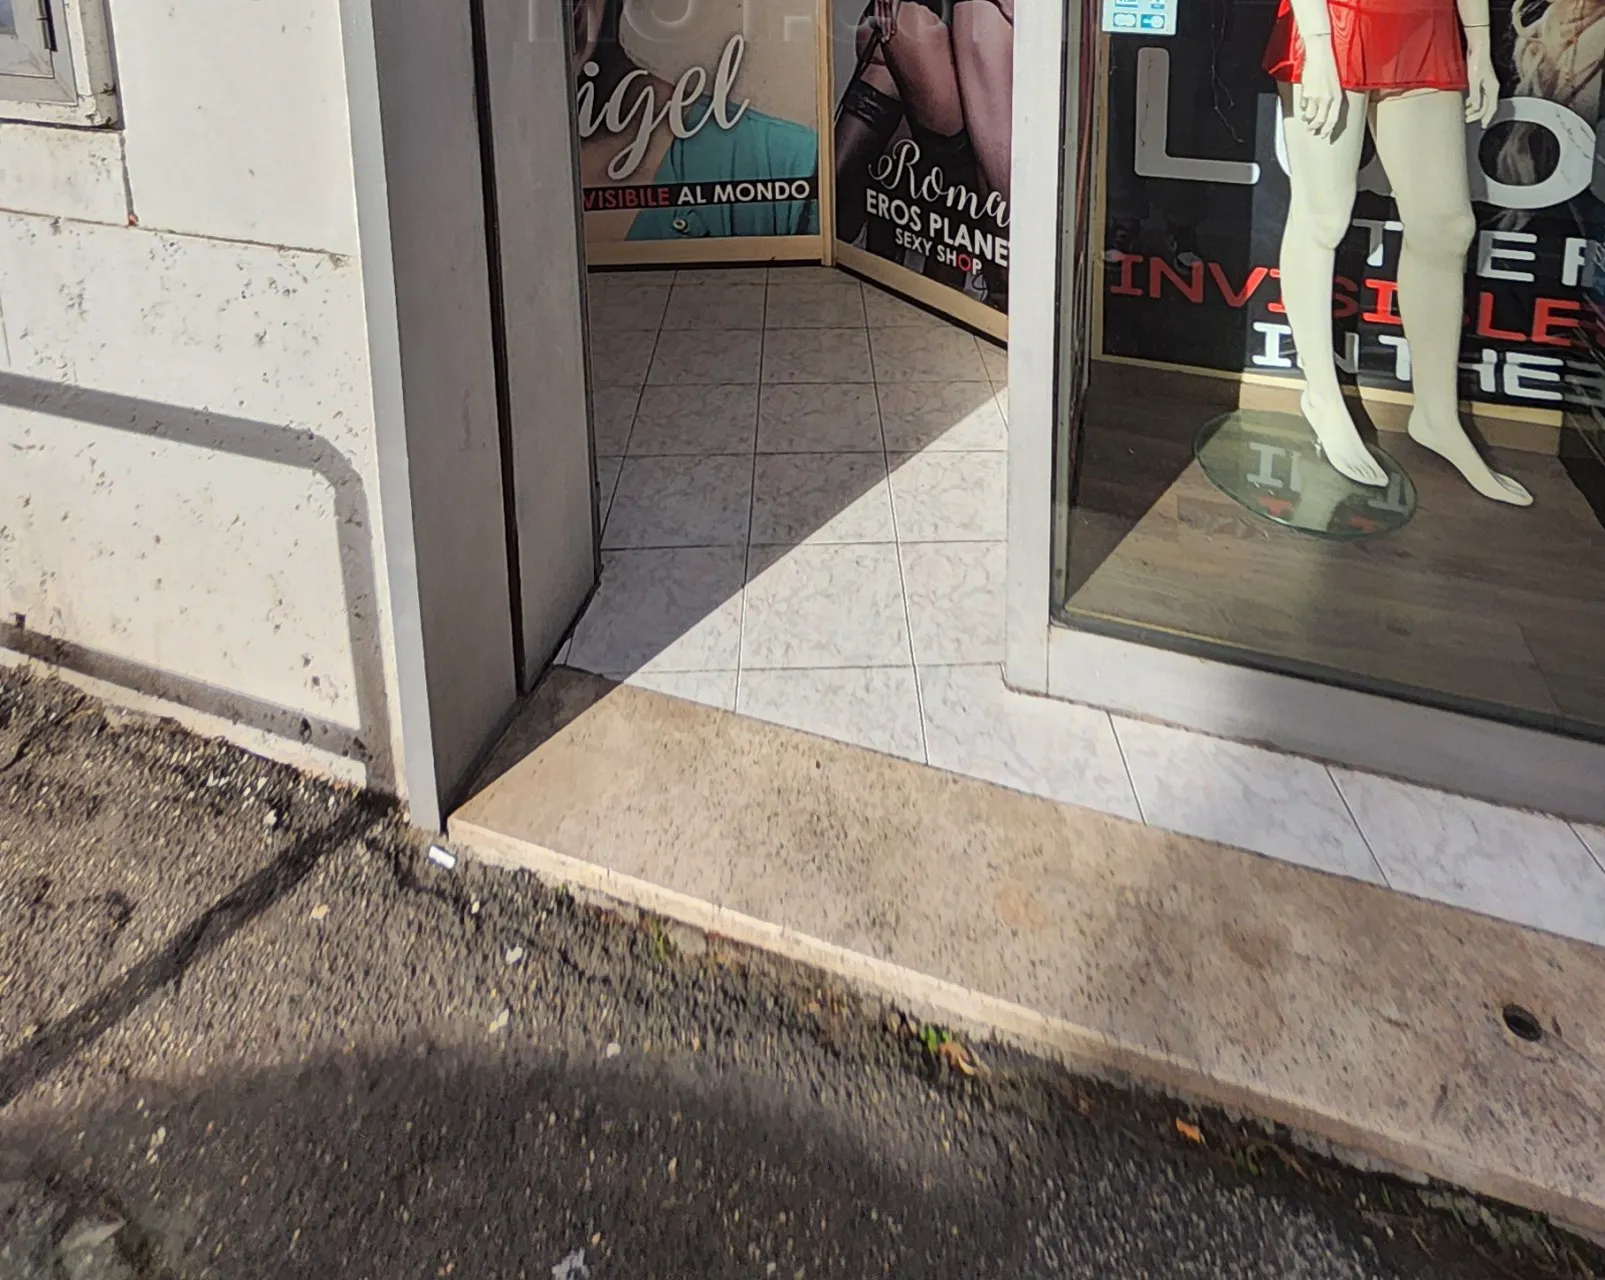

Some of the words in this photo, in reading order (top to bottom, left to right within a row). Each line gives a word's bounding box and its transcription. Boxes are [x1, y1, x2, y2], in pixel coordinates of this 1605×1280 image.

[677, 185, 707, 205] AL
[713, 180, 810, 203] MONDO
[868, 138, 1011, 228] Roma
[866, 188, 922, 232] EROS
[929, 212, 1011, 267] PLANE
[895, 228, 933, 257] SEXY
[936, 245, 983, 275] SHOP
